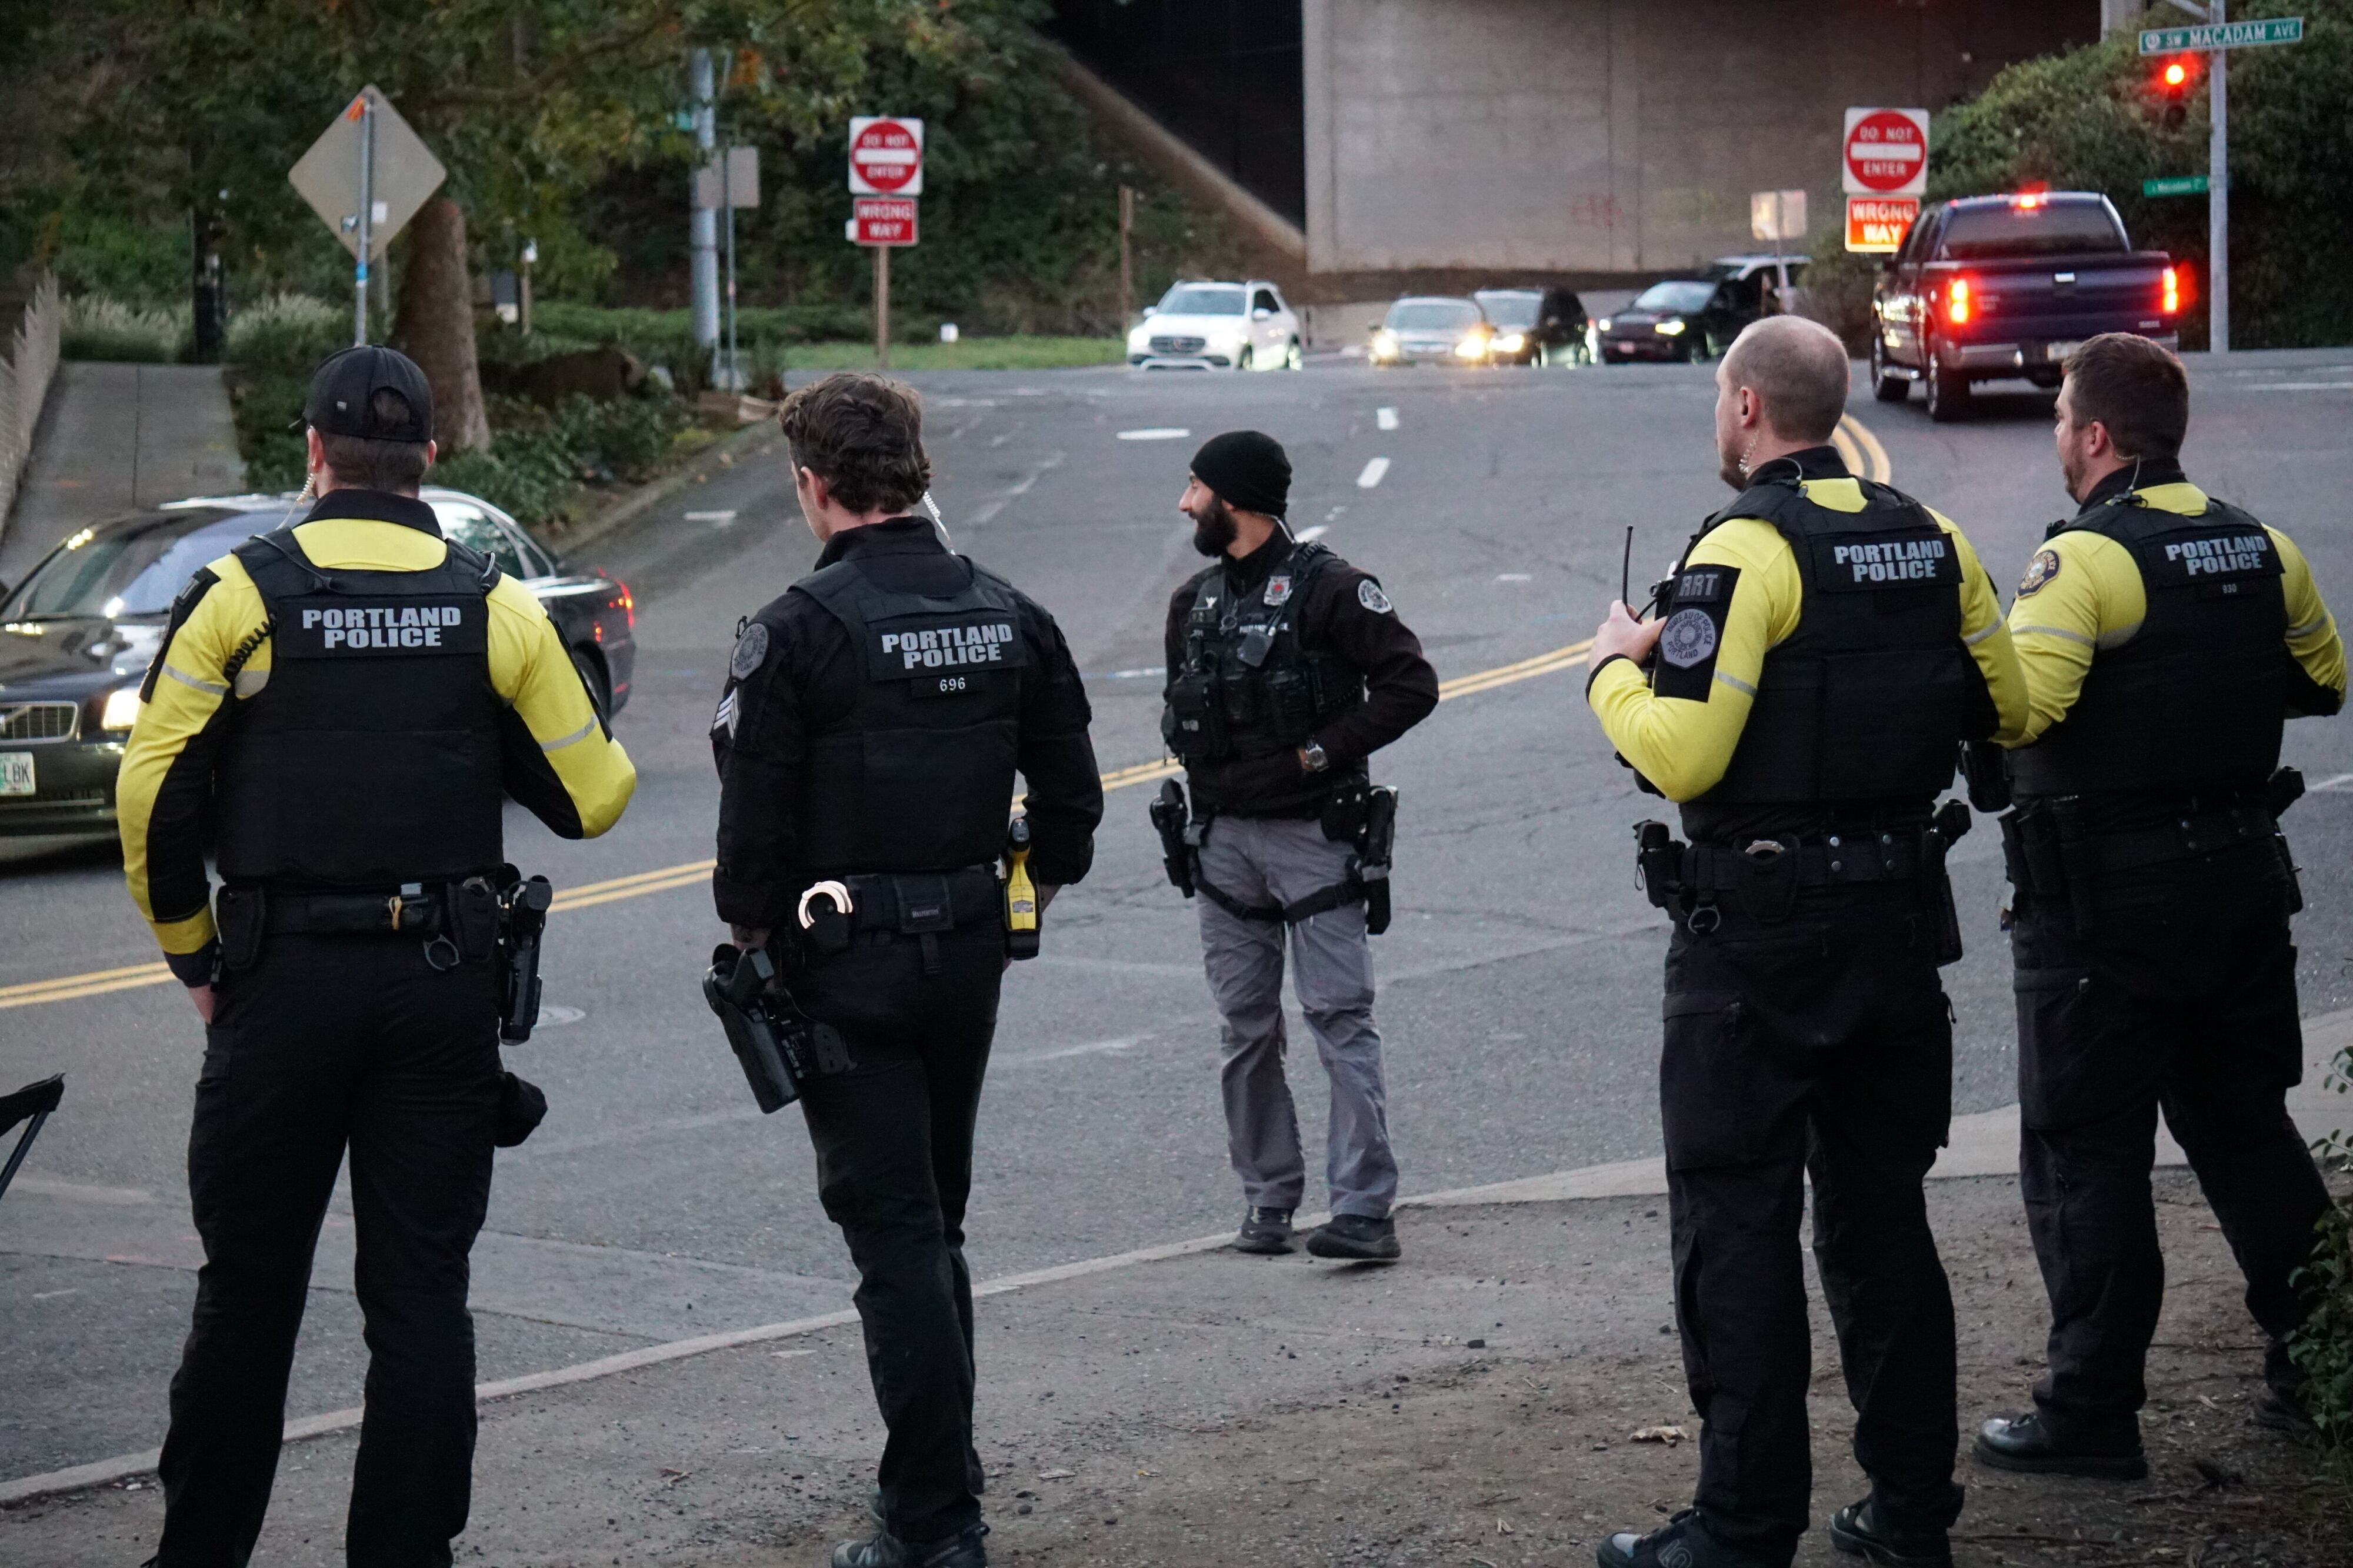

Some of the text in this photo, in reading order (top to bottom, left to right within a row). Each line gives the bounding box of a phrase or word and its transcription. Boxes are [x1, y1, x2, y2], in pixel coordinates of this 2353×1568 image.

[2167, 33, 2182, 46] SW
[2190, 24, 2265, 46] MACADAM
[2274, 24, 2295, 38] AVE
[862, 133, 909, 147] DO NOT
[1859, 126, 1913, 141] DO NOT
[866, 165, 906, 179] ENTER
[1863, 161, 1907, 176] ENTER
[858, 203, 912, 221] WRONG
[1853, 202, 1914, 222] WRONG
[868, 222, 904, 238] WAY
[1863, 223, 1902, 243] WAY
[1834, 540, 1945, 565] PORTLAND
[2165, 536, 2268, 562] PORTLAND
[1852, 559, 1937, 583] POLICE
[2186, 552, 2263, 576] POLICE
[1679, 573, 1718, 597] RRT
[302, 606, 461, 629] PORTLAND
[324, 627, 442, 648] POLICE
[881, 623, 1013, 653] PORTLAND
[1667, 612, 1694, 632] BUREAU
[1702, 619, 1713, 646] POLICE
[904, 643, 1002, 669] POLICE
[1666, 641, 1698, 659] PORTLAND
[939, 677, 966, 692] 696
